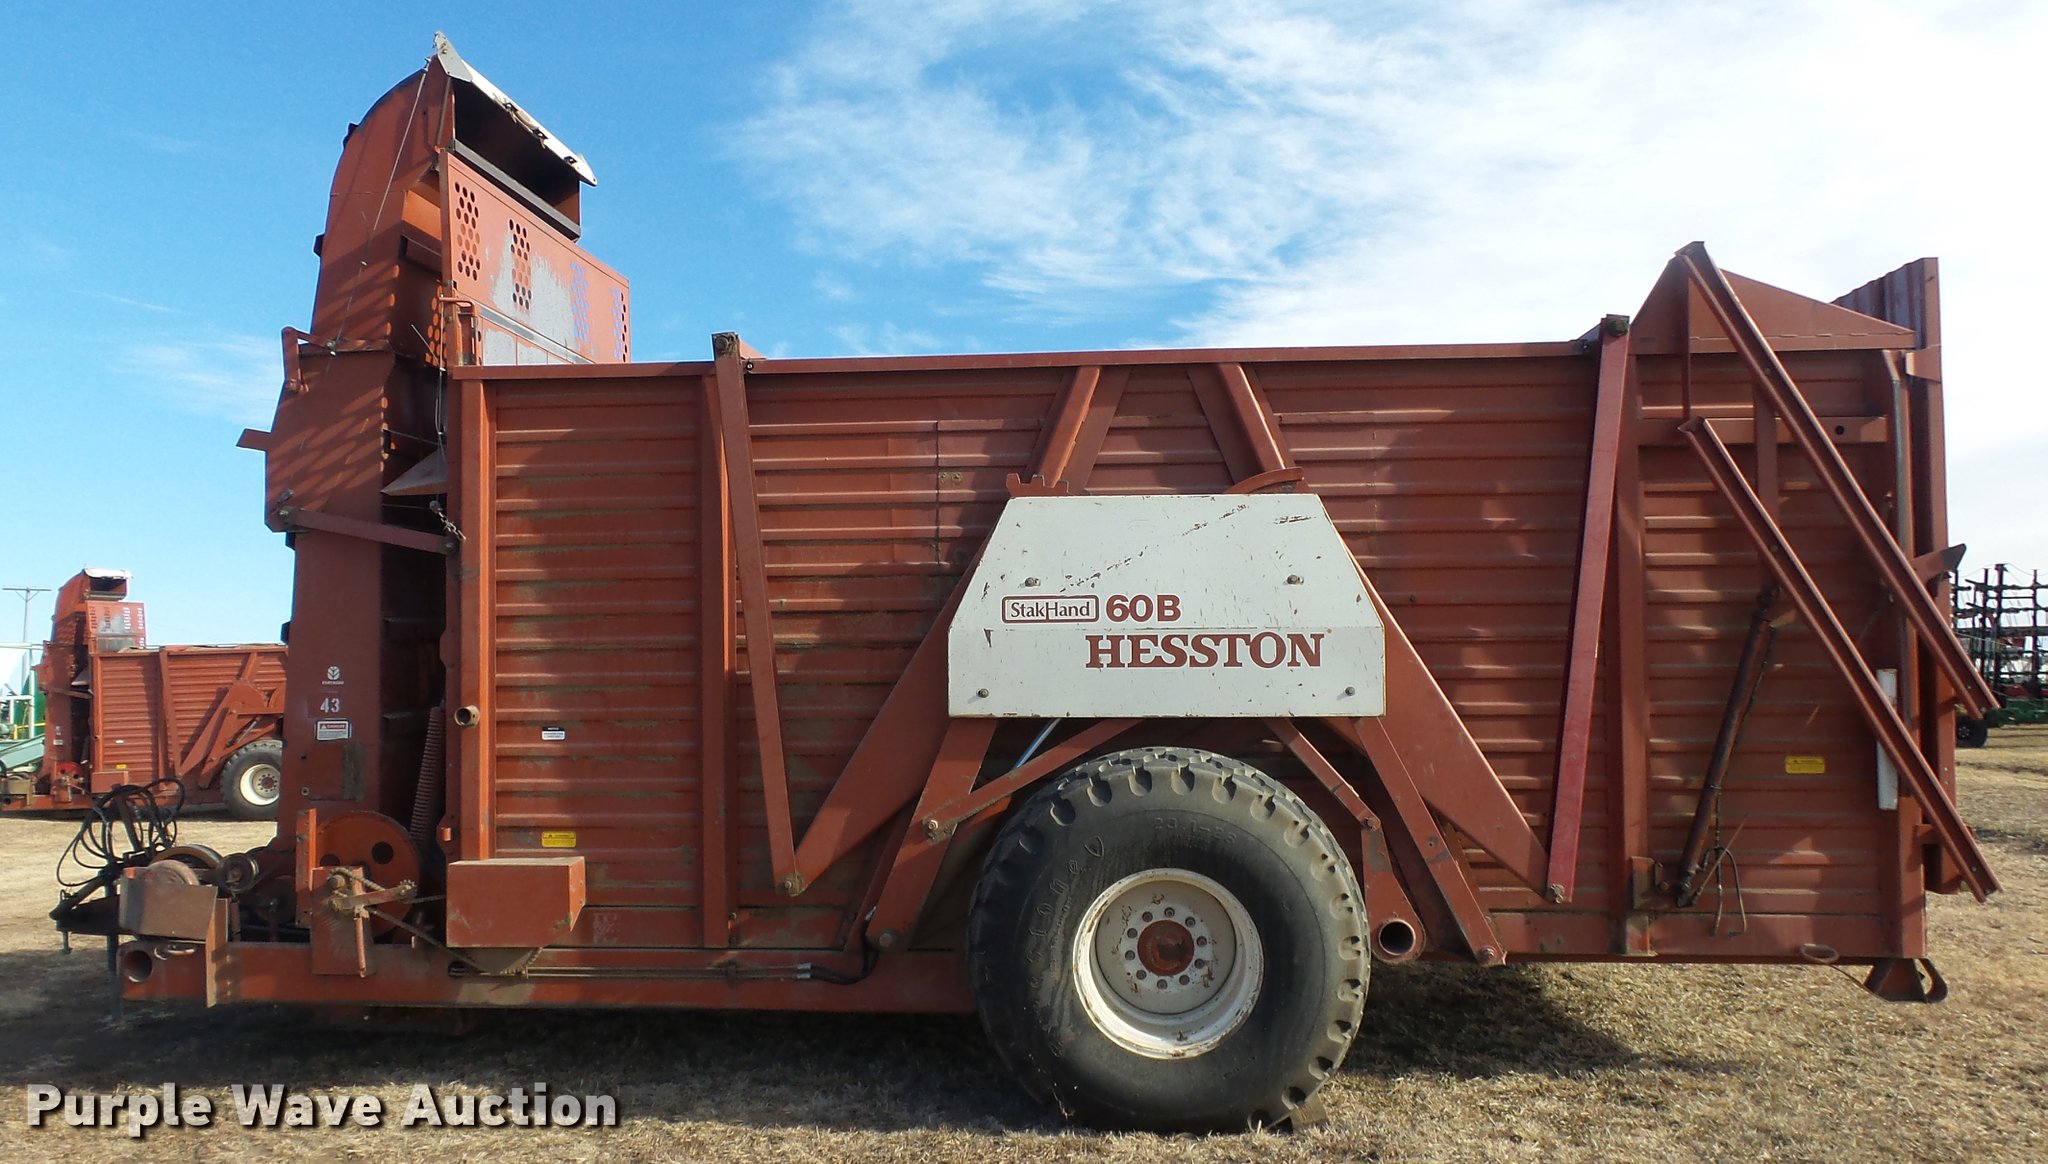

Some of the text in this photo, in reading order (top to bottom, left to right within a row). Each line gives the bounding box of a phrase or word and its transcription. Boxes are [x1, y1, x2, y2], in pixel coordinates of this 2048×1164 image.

[1010, 594, 1182, 623] StakHand 60B
[1085, 632, 1325, 669] HESSTON
[320, 697, 340, 713] 43
